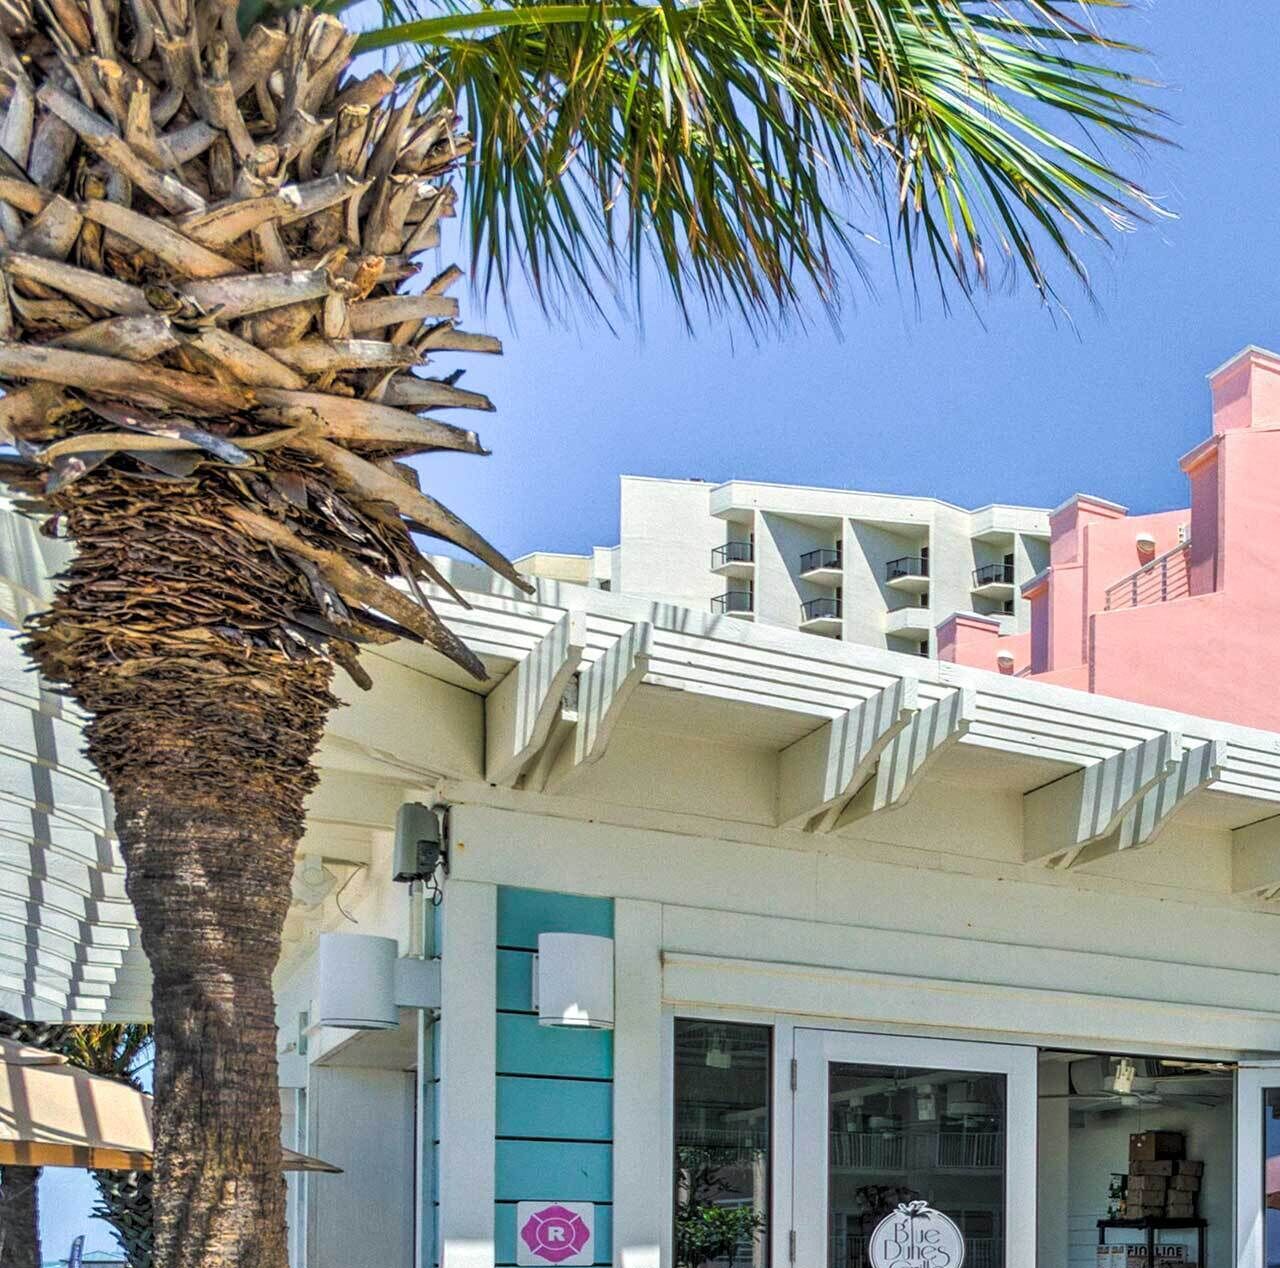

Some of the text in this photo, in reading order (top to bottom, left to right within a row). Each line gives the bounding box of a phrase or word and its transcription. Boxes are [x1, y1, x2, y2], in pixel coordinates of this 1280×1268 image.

[547, 1226, 566, 1241] R
[894, 1220, 940, 1244] Blue
[884, 1240, 951, 1268] Dunes
